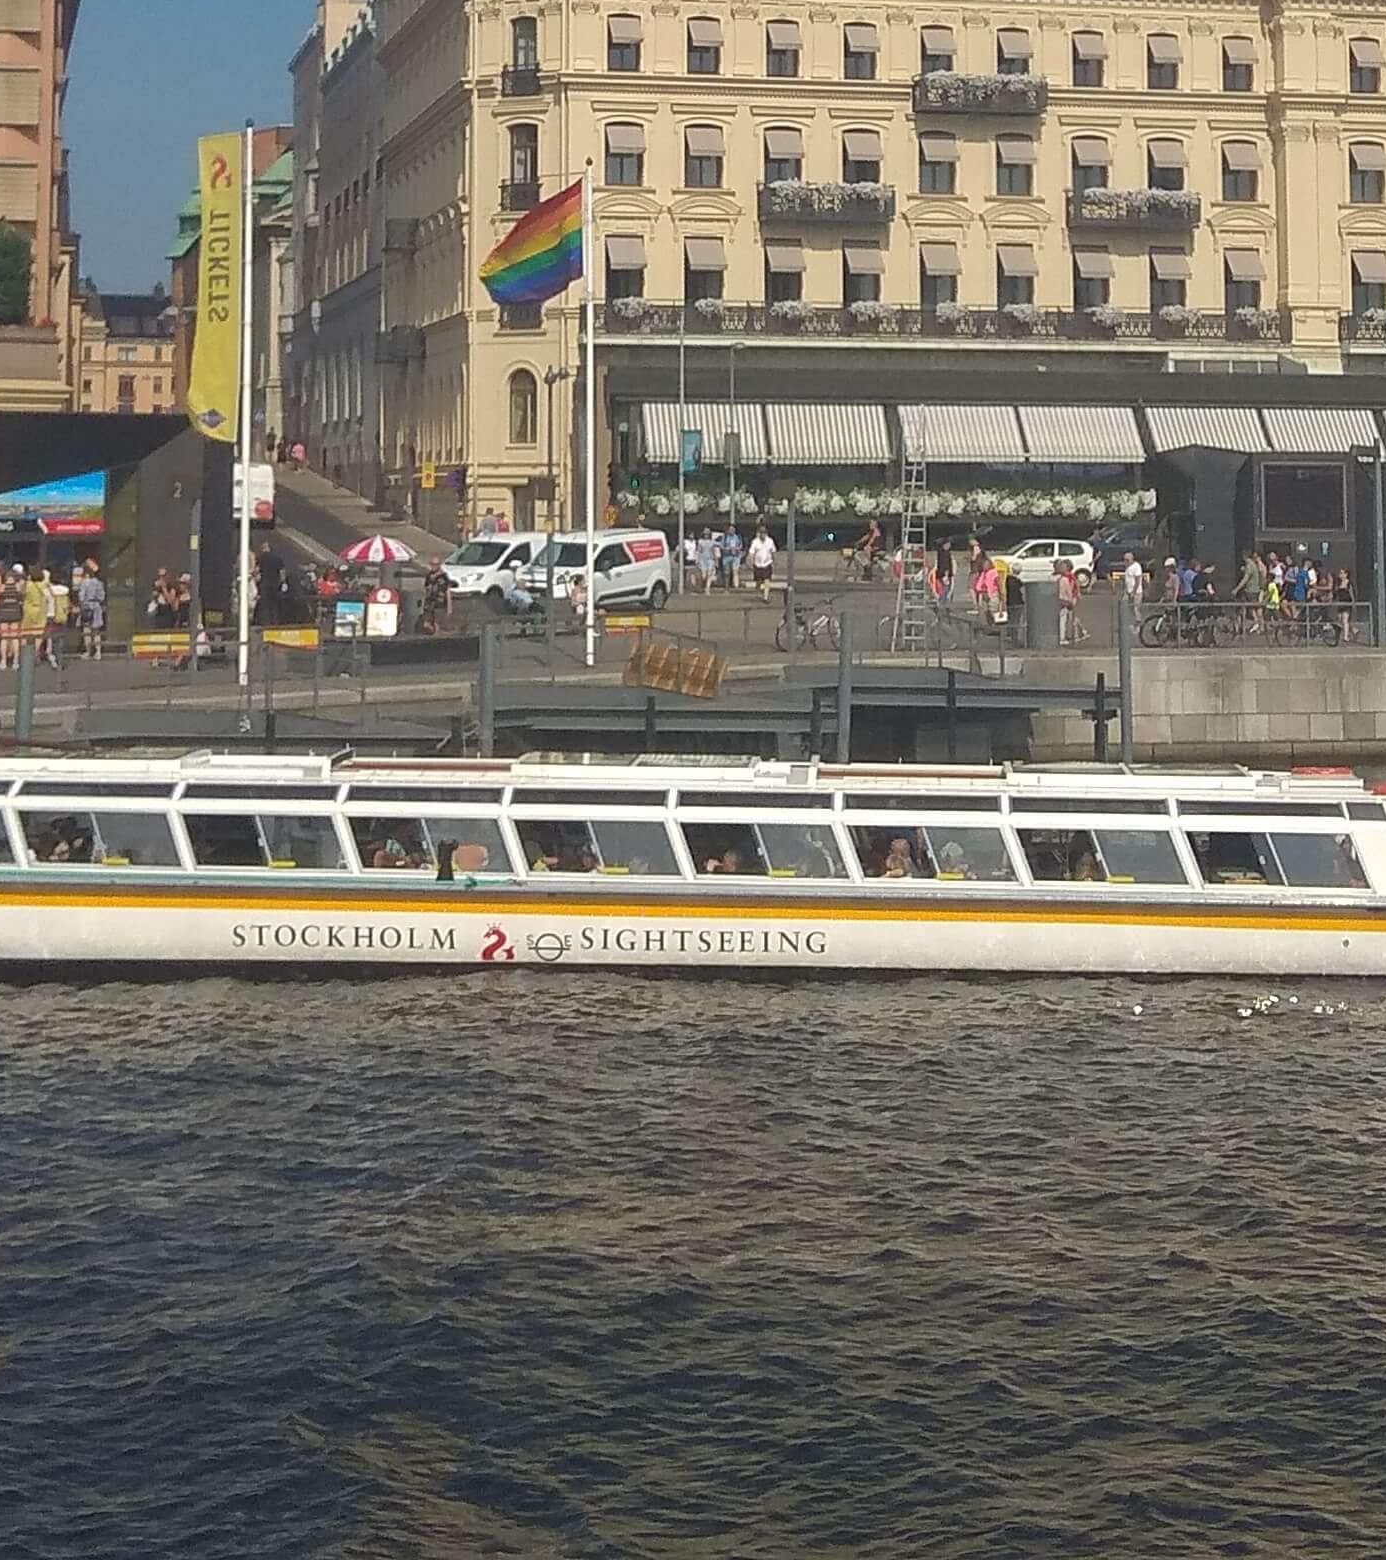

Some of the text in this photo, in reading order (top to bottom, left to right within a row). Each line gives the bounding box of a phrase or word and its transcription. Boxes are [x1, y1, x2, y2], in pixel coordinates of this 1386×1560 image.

[173, 480, 182, 498] 2
[232, 924, 457, 951] STOCKHOLM
[580, 926, 829, 955] SIGHTSEEING
